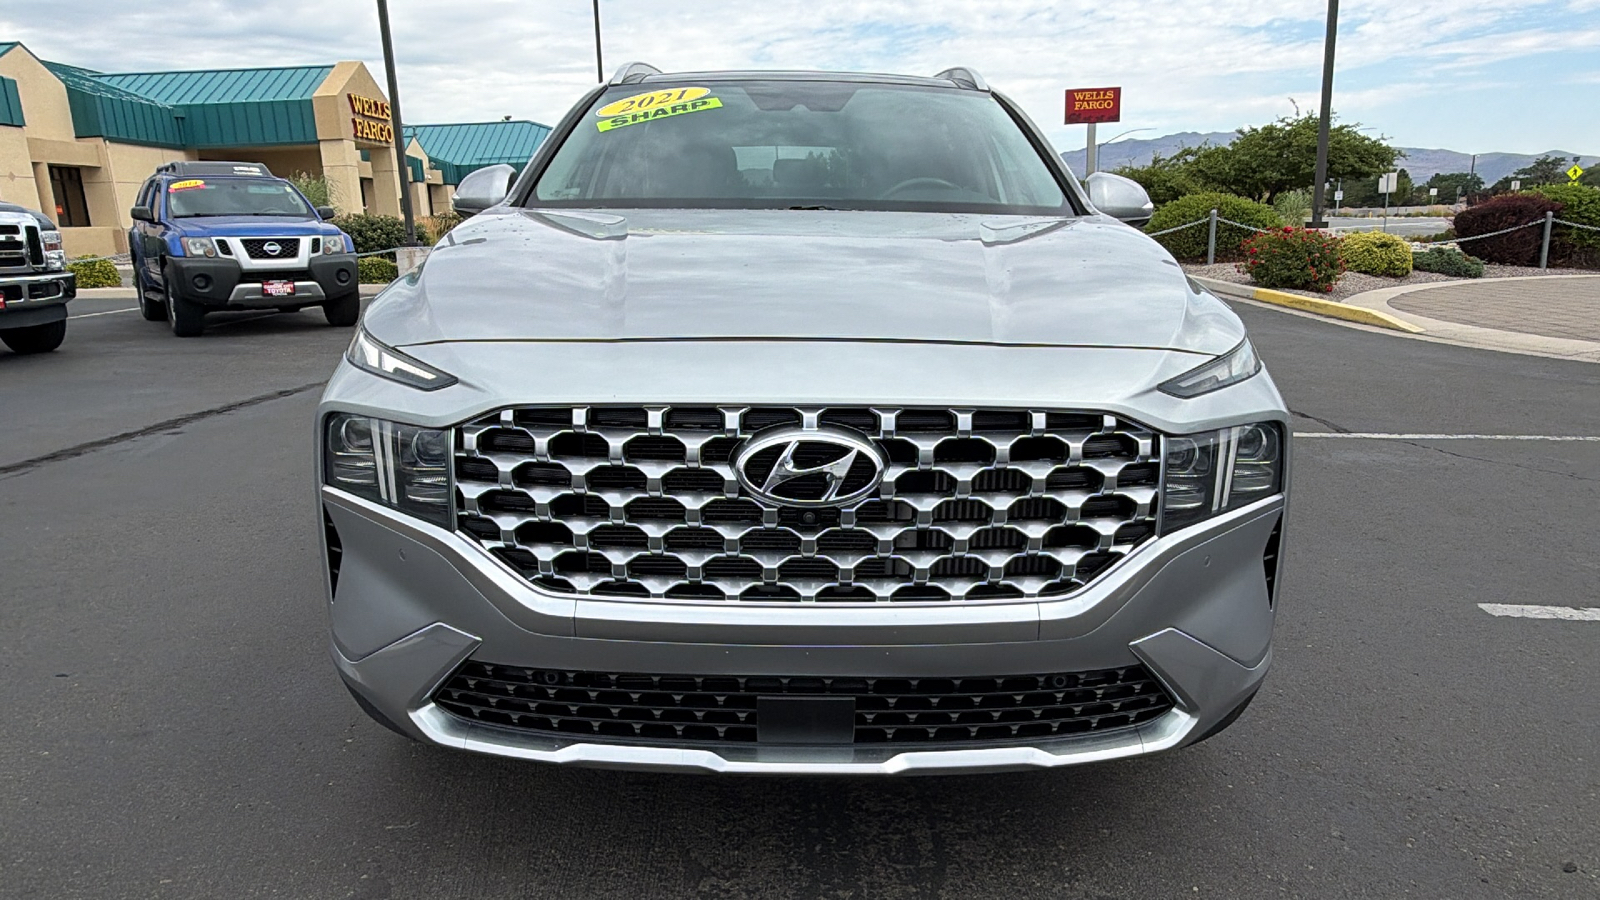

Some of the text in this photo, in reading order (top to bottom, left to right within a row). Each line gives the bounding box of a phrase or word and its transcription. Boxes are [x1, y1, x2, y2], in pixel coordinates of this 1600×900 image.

[349, 92, 391, 121] WELLS
[618, 89, 688, 114] 2021
[1073, 90, 1114, 101] WELLS
[1074, 100, 1114, 111] FARGO
[610, 100, 711, 127] SHARP
[353, 118, 393, 143] FARGO
